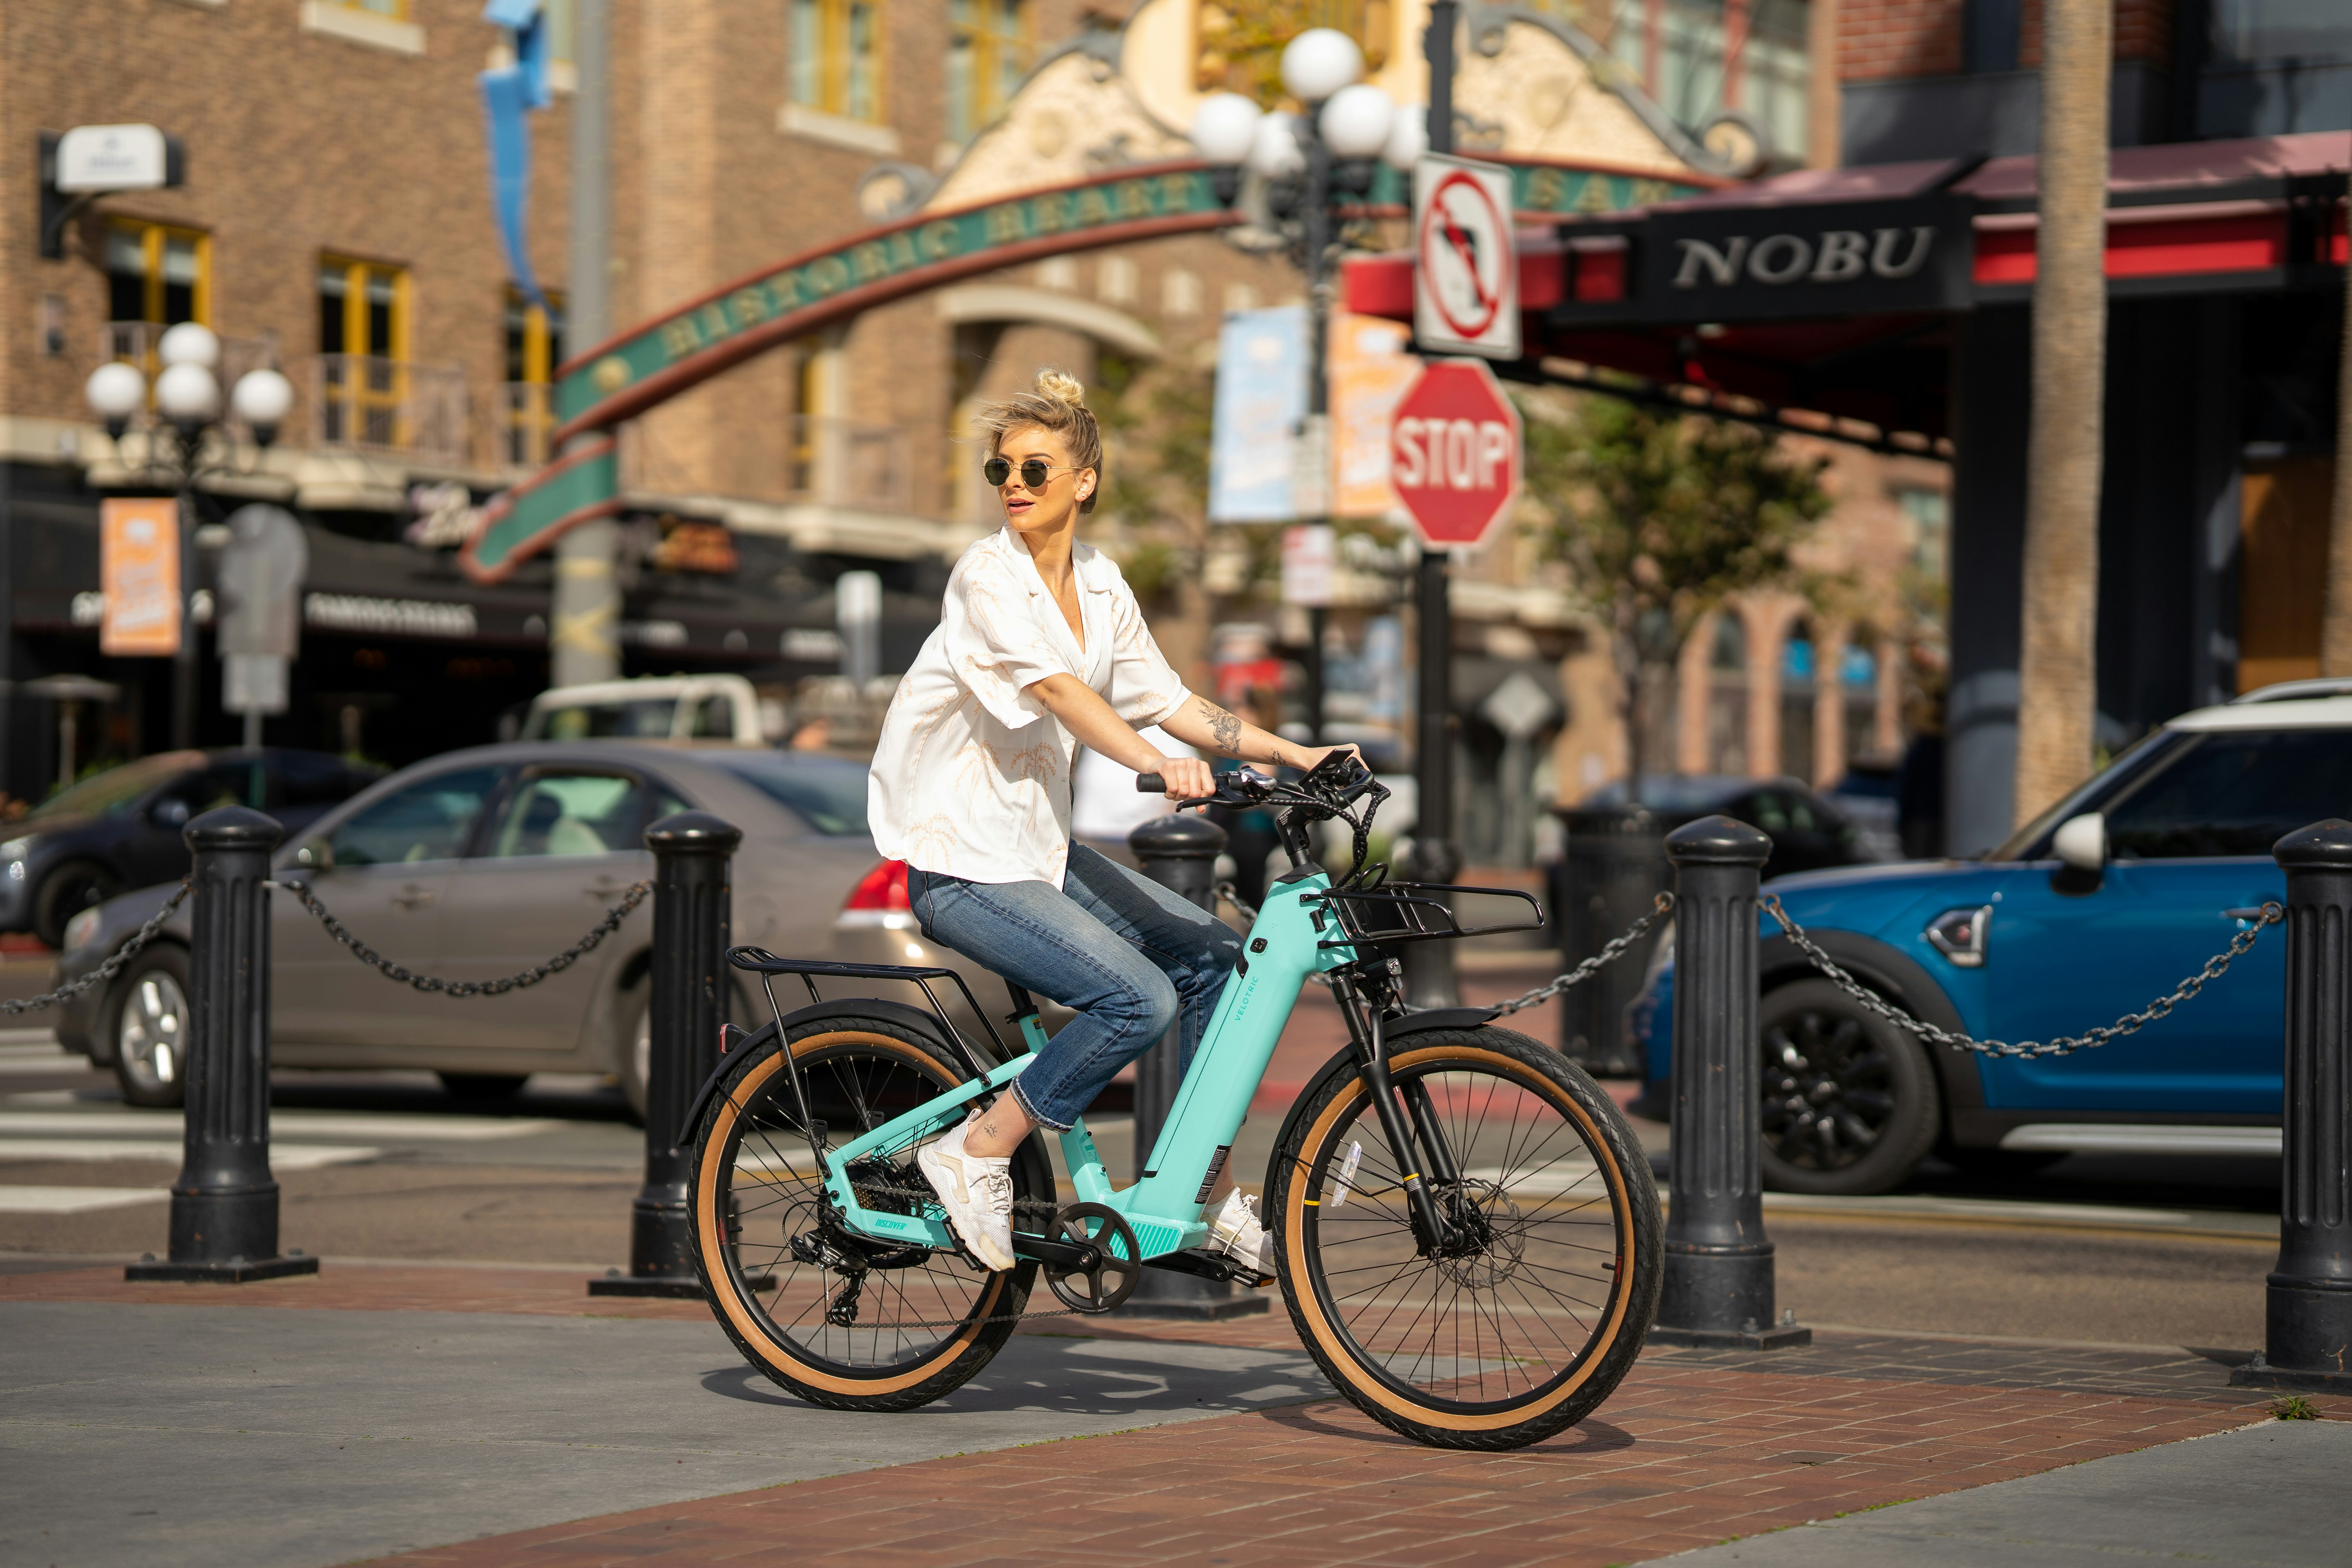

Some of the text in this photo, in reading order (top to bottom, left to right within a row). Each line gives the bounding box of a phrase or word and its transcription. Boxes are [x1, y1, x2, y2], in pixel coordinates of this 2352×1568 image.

[662, 219, 961, 359] HISTORIC
[985, 173, 1199, 244] HEART
[1671, 225, 1936, 289] NOBU
[1392, 416, 1512, 490] STOP
[1279, 809, 1293, 820] VELOTRIC
[1235, 976, 1258, 1020] VELOTRIC
